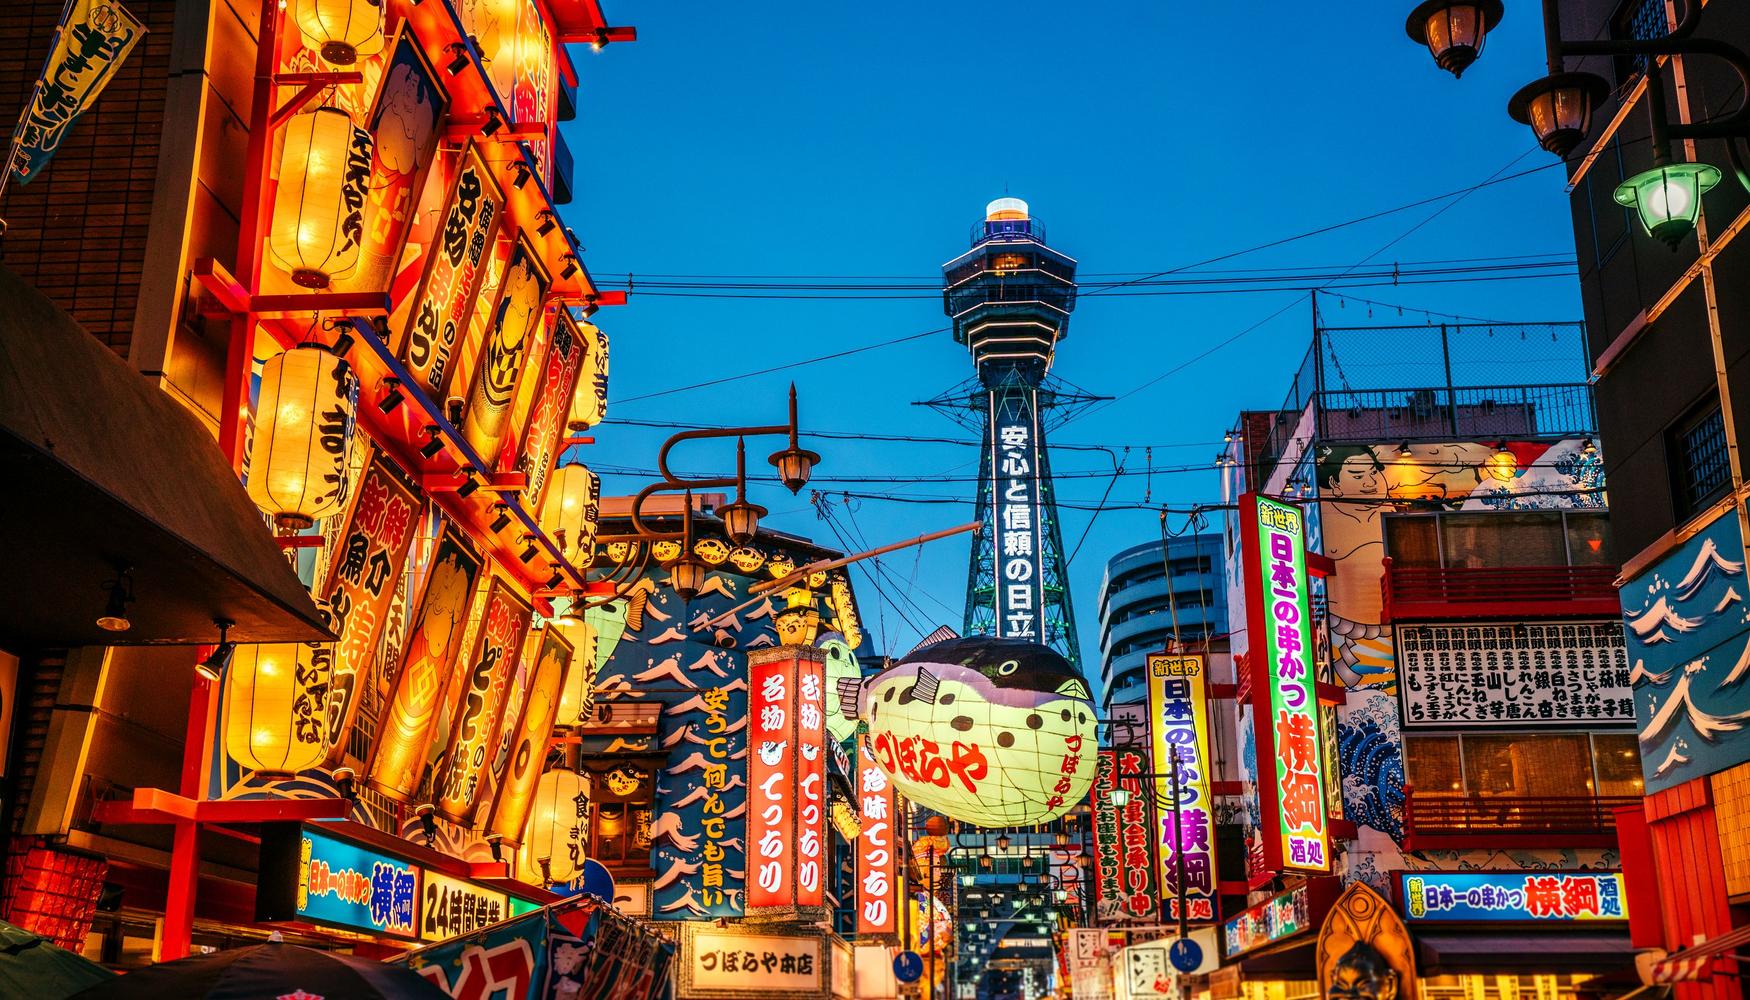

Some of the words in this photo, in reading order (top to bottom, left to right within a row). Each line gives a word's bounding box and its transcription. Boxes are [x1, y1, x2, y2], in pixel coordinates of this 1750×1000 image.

[410, 167, 483, 369] 名物串かつ
[357, 473, 411, 553] 新鮮
[1000, 425, 1034, 642] 安心と信頼の日立
[1260, 502, 1300, 536] 新世界
[339, 532, 391, 598] 魚介
[1271, 532, 1307, 708] 日本一の串かつ
[1153, 659, 1200, 677] 新世界
[760, 672, 787, 732] 名物
[799, 673, 821, 731] 名物
[1408, 674, 1424, 720] もち
[1424, 673, 1441, 720] うずら玉子
[1439, 673, 1457, 719] 紅しょうが
[1455, 673, 1472, 719] にんにく
[1471, 673, 1490, 719] 玉ねぎ
[1487, 673, 1505, 719] 山芋
[1503, 673, 1521, 719] しし唐
[1519, 673, 1537, 718] れんこん
[1534, 672, 1553, 718] 銀杏
[1551, 672, 1569, 718] 白ねぎ
[1567, 671, 1585, 717] さつま芋
[1583, 671, 1600, 717] じゃが芋
[1599, 672, 1618, 717] 茄子
[1615, 670, 1633, 717] 椎茸
[873, 730, 988, 794] づぼらや
[1163, 679, 1200, 805] 日本一の串かつ
[1046, 733, 1084, 811] づぼらや
[1275, 710, 1324, 834] 横綱
[701, 685, 729, 907] 安うて何んでも旨い
[758, 772, 785, 894] てっちり
[799, 772, 820, 893] てっちり
[862, 764, 890, 927] 珍味てっちり
[1162, 807, 1213, 896] 横綱
[1289, 838, 1324, 866] 酒処
[309, 860, 370, 905] 日本一の串かつ
[370, 863, 415, 931] 横綱
[1409, 878, 1426, 917] 新世界
[1425, 884, 1524, 912] 日本一の串かつ
[1524, 876, 1599, 917] 横綱
[1599, 877, 1621, 916] 酒処
[700, 950, 814, 976] づぼらや本店
